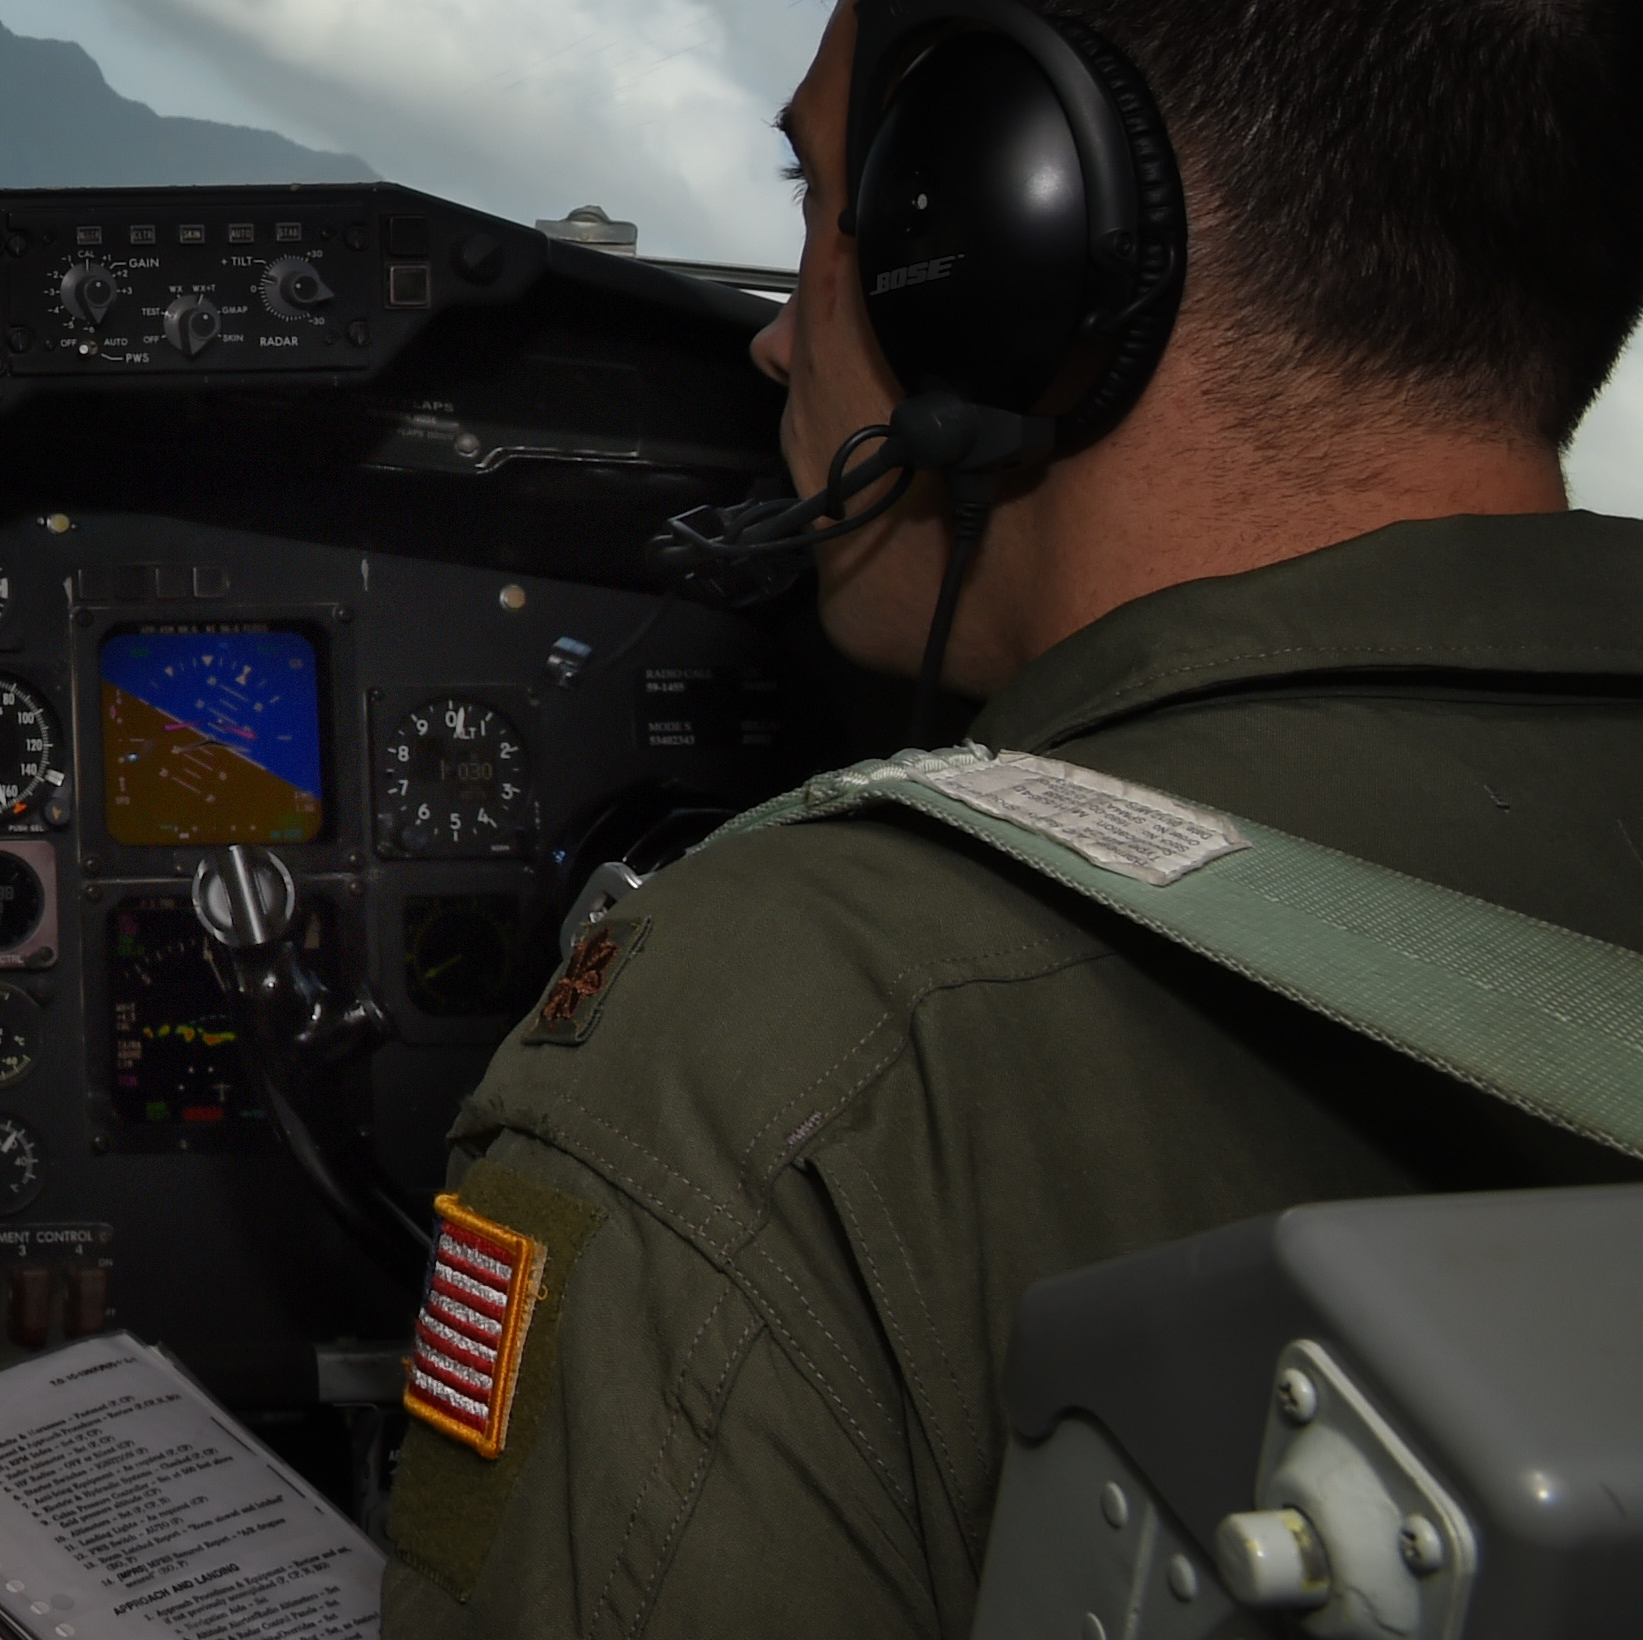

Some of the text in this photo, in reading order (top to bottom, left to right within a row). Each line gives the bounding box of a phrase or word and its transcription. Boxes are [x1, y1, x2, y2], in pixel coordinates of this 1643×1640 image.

[129, 258, 159, 268] GAIN
[869, 256, 956, 296] BOSE
[260, 336, 298, 346] RADAR
[36, 1230, 93, 1243] CONTROL
[114, 1563, 240, 1615] APPROACH AND LANDING
